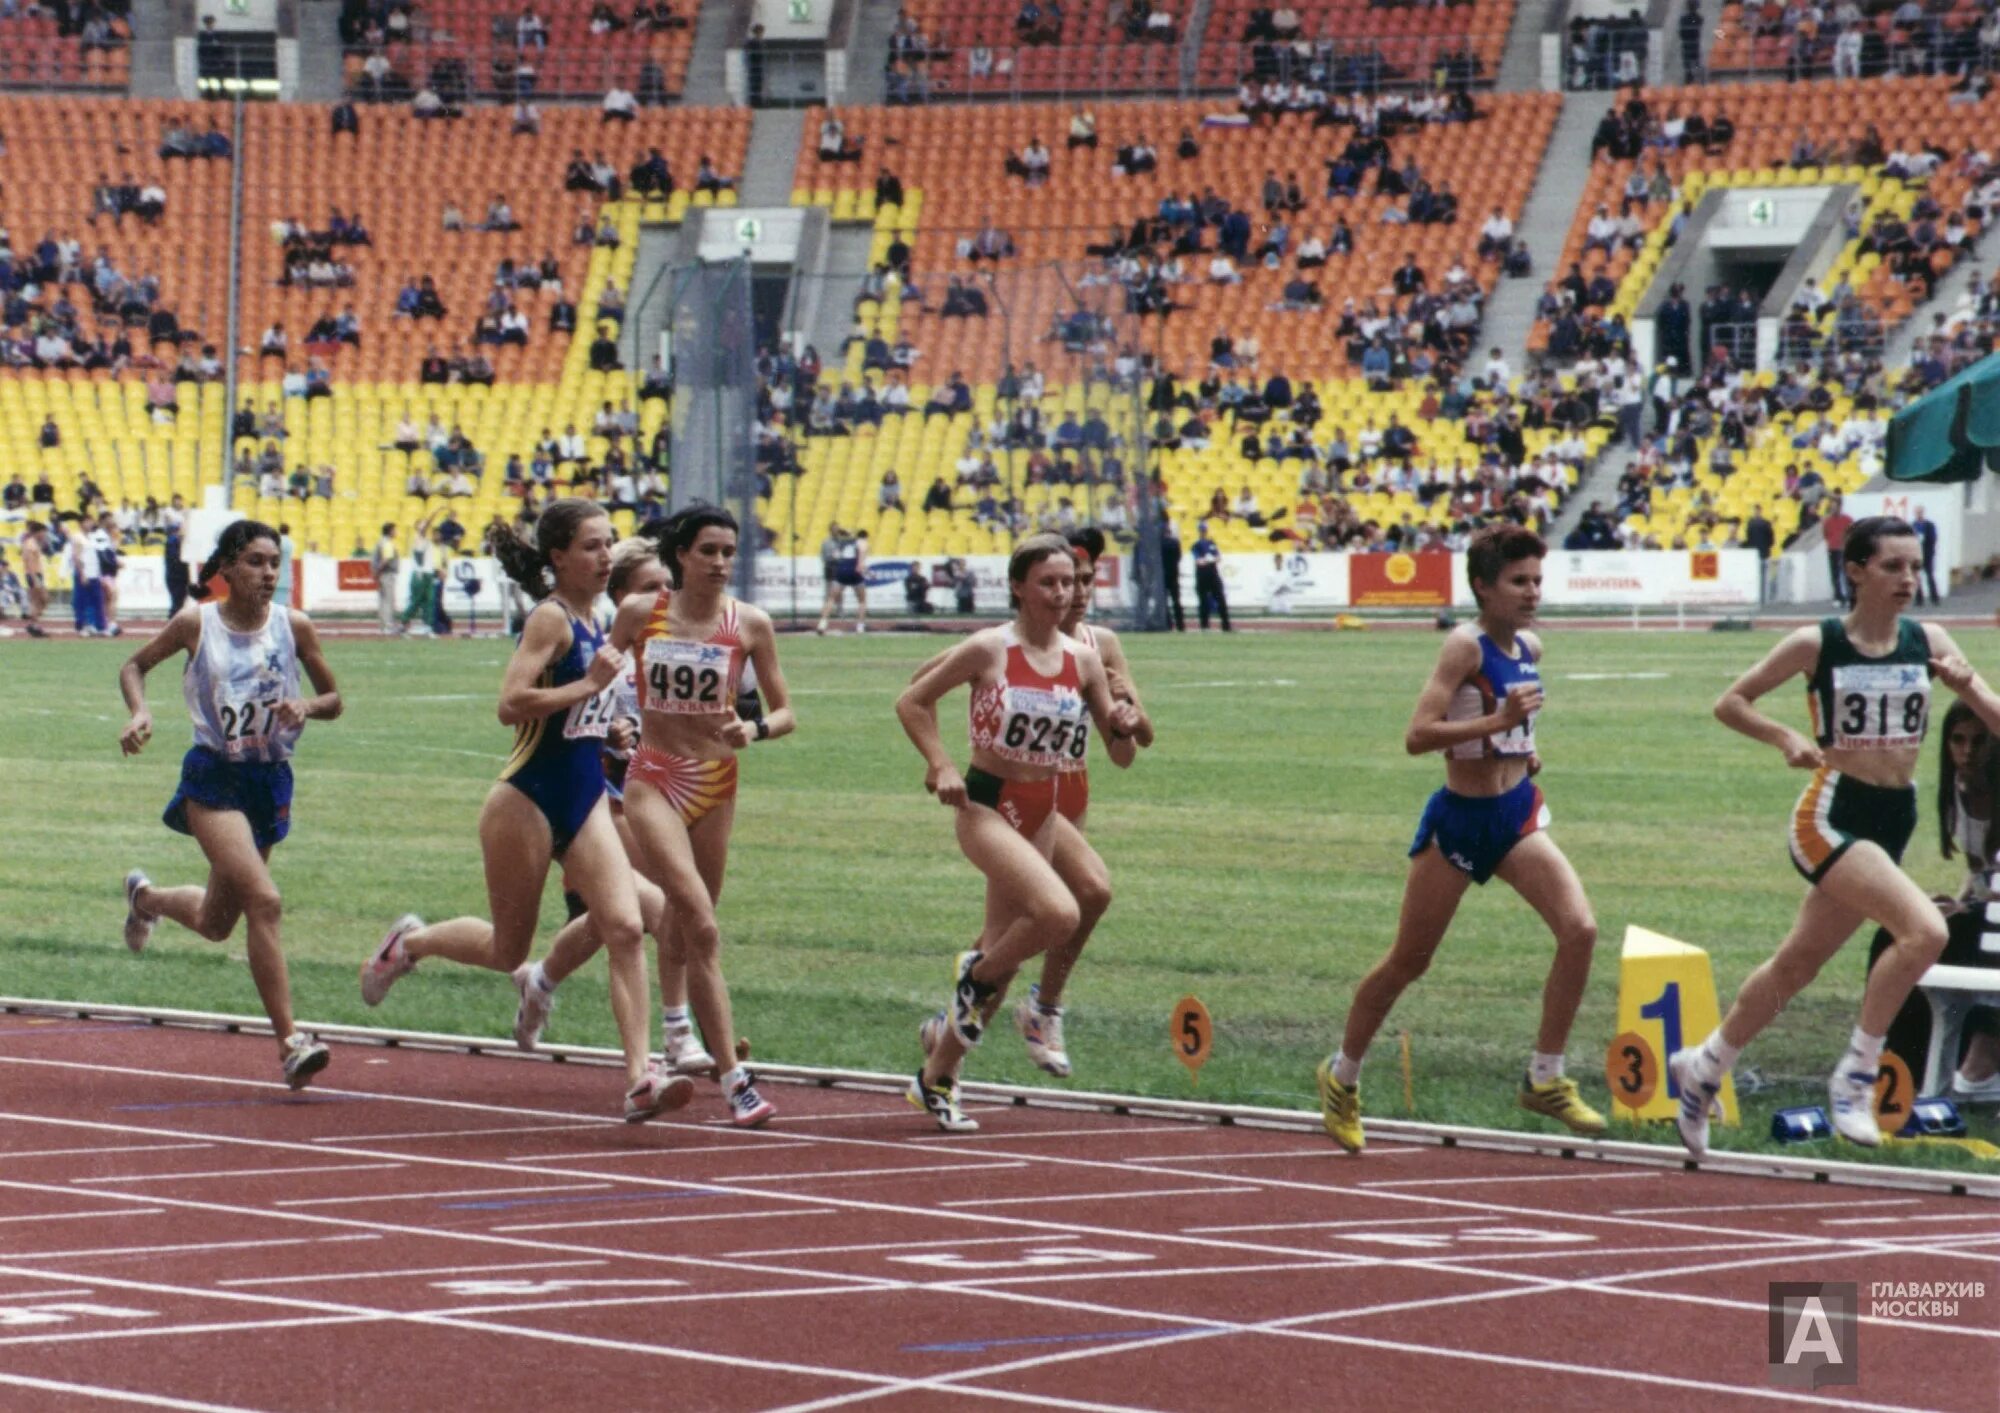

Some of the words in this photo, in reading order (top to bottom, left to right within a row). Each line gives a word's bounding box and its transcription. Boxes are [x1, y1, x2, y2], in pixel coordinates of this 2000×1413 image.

[740, 219, 756, 241] 4
[1751, 201, 1768, 224] 4
[650, 662, 720, 701] 492
[220, 698, 277, 741] 227
[1841, 692, 1924, 735] 318
[1182, 1011, 1202, 1056] 5
[1641, 982, 1683, 1098] 1
[1619, 1046, 1643, 1094] 3
[1877, 1064, 1899, 1115] 2
